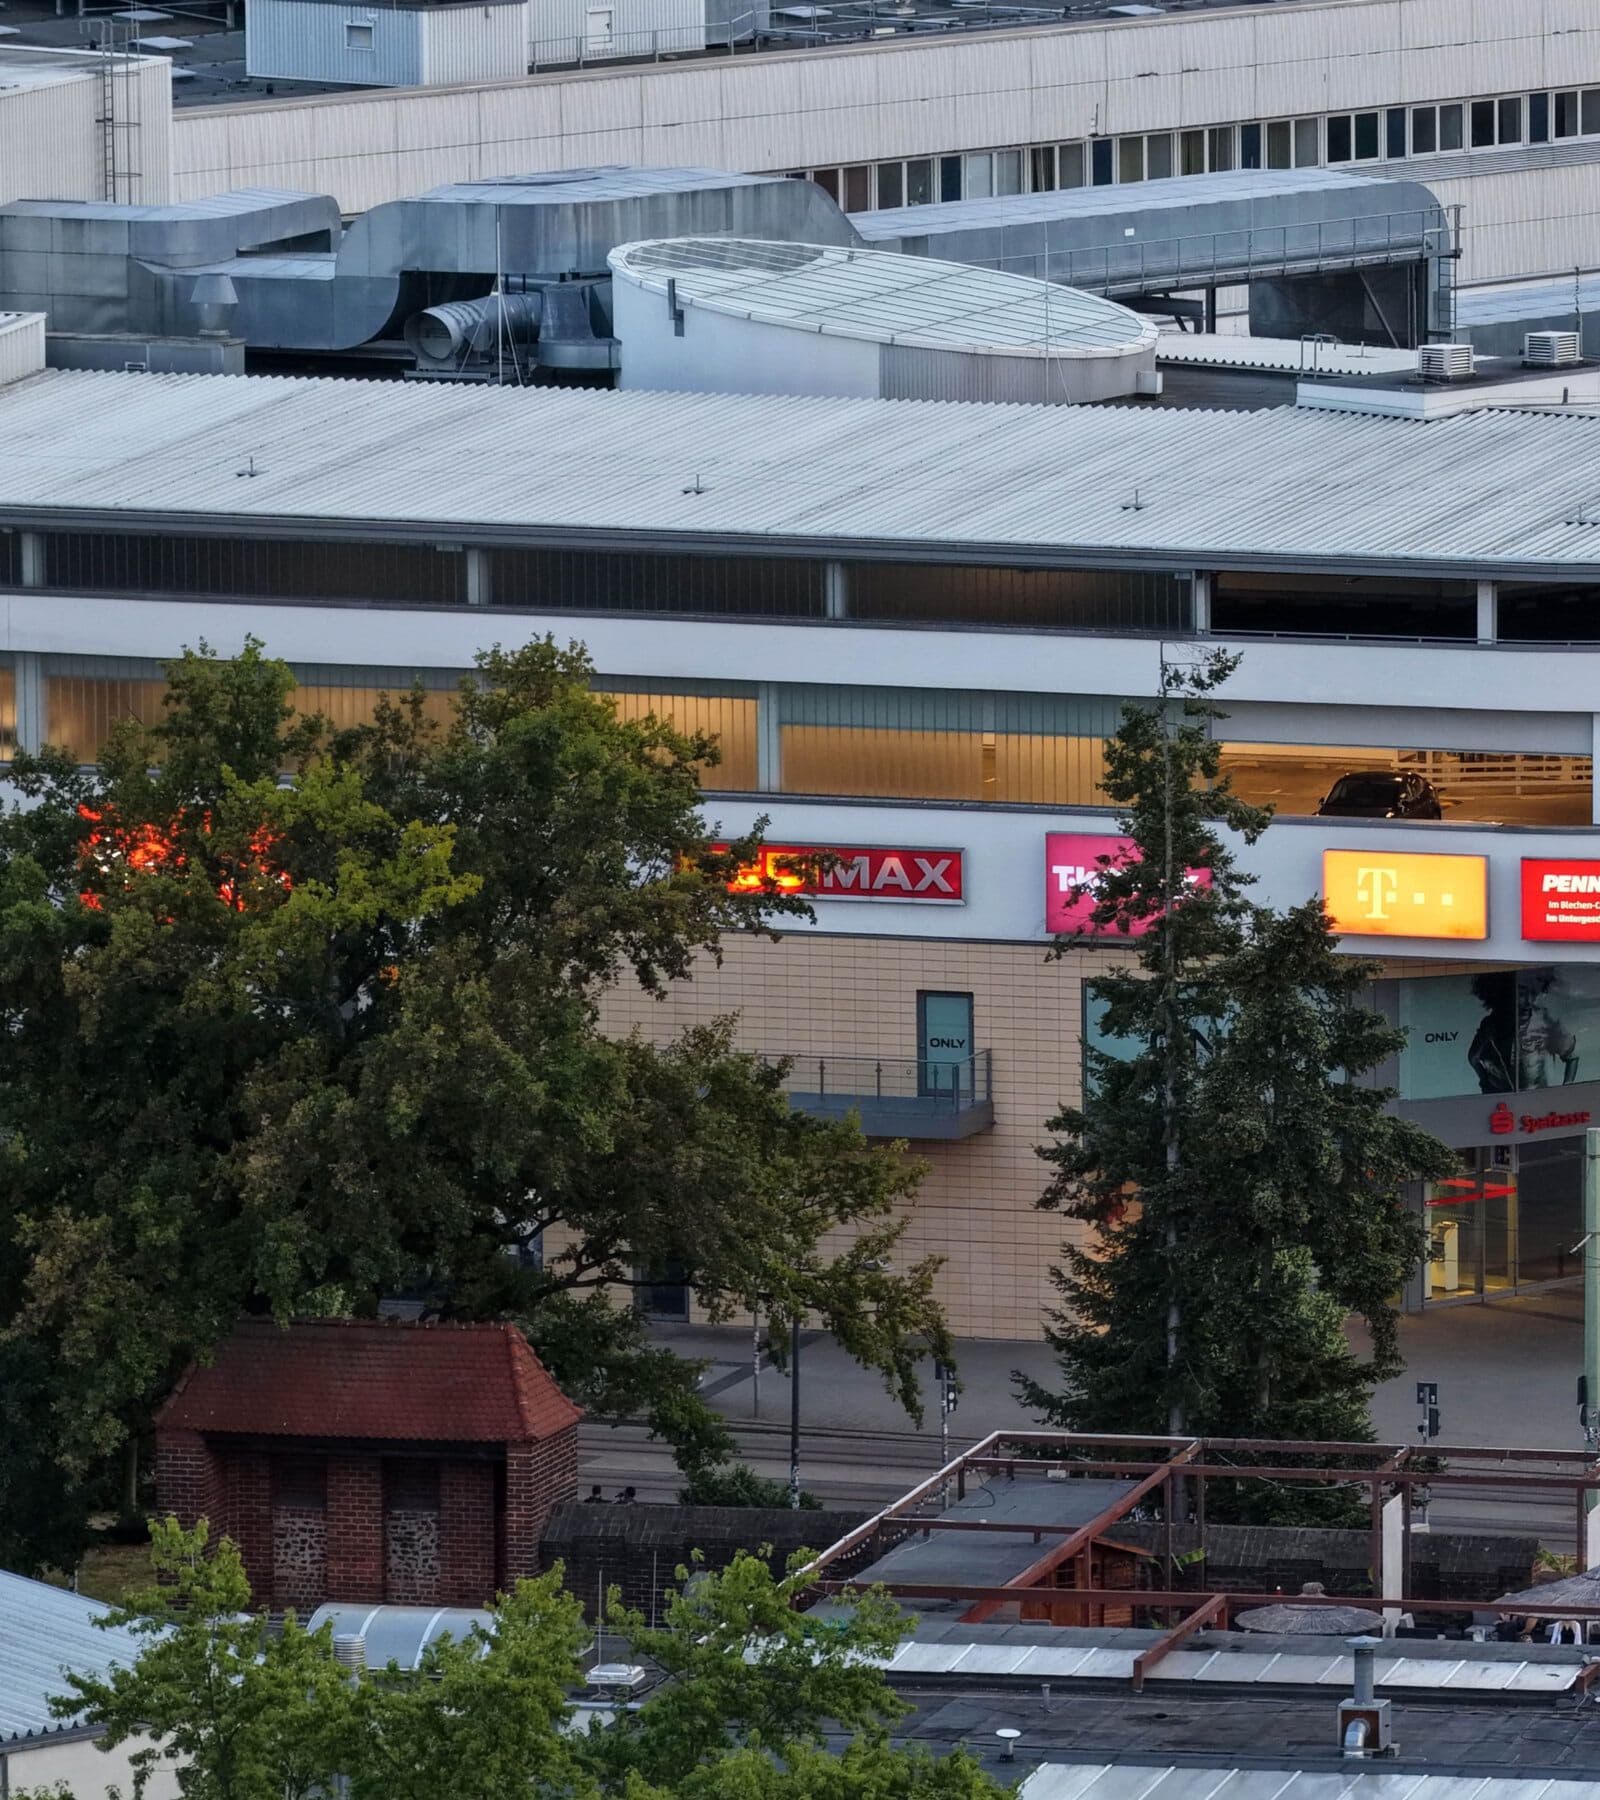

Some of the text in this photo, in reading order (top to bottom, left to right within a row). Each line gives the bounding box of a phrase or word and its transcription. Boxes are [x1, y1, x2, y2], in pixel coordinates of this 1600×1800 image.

[929, 1037, 966, 1048] ONLY
[1425, 1031, 1460, 1043] ONLY
[1520, 1111, 1591, 1134] Sparkasse
